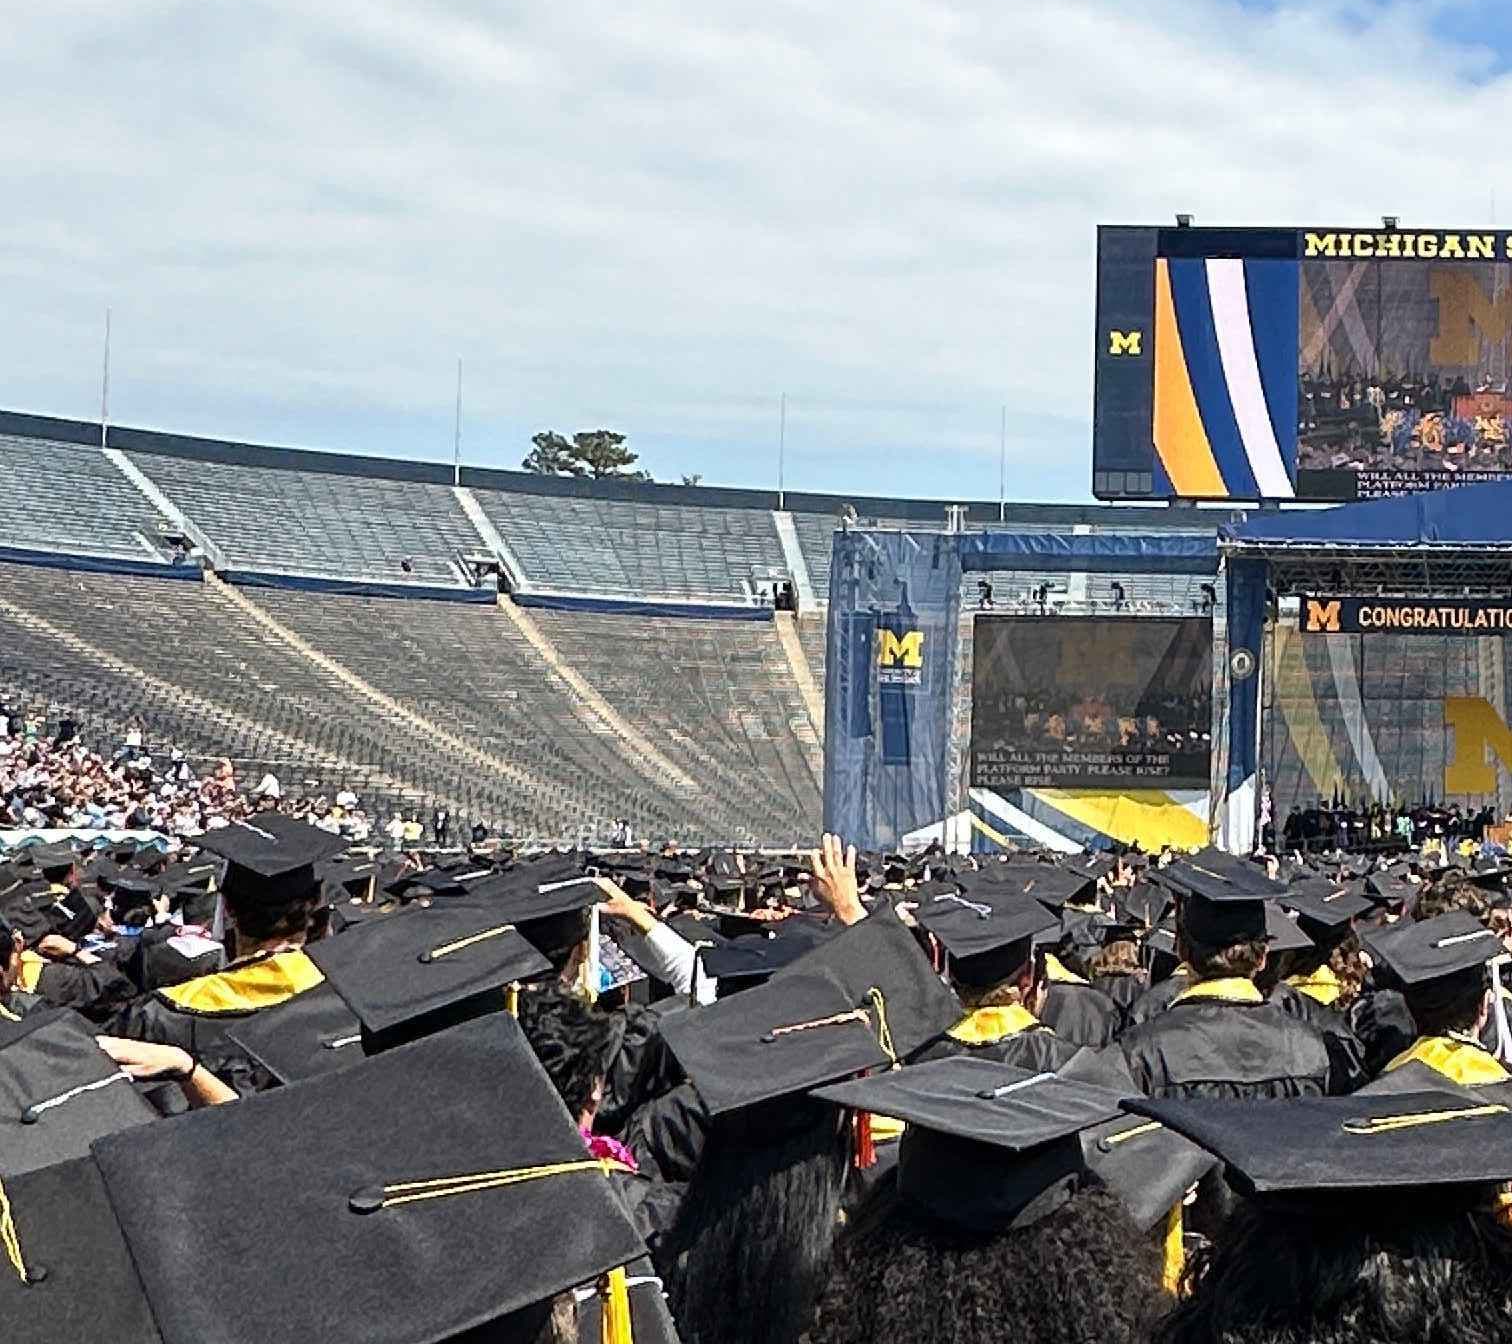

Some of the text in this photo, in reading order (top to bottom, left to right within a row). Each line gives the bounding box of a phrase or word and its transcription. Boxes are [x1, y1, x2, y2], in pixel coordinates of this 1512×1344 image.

[1304, 233, 1496, 258] MICHIGAN
[1109, 330, 1142, 354] M
[1357, 471, 1391, 480] WILL
[1394, 471, 1420, 480] ALL
[1424, 472, 1450, 480] THE
[1306, 600, 1342, 632] M
[876, 628, 924, 667] M
[976, 752, 1006, 762] WILL
[1009, 752, 1031, 762] ALL
[1035, 752, 1059, 763] THE
[1126, 754, 1143, 764] OF
[1146, 754, 1169, 765] THE
